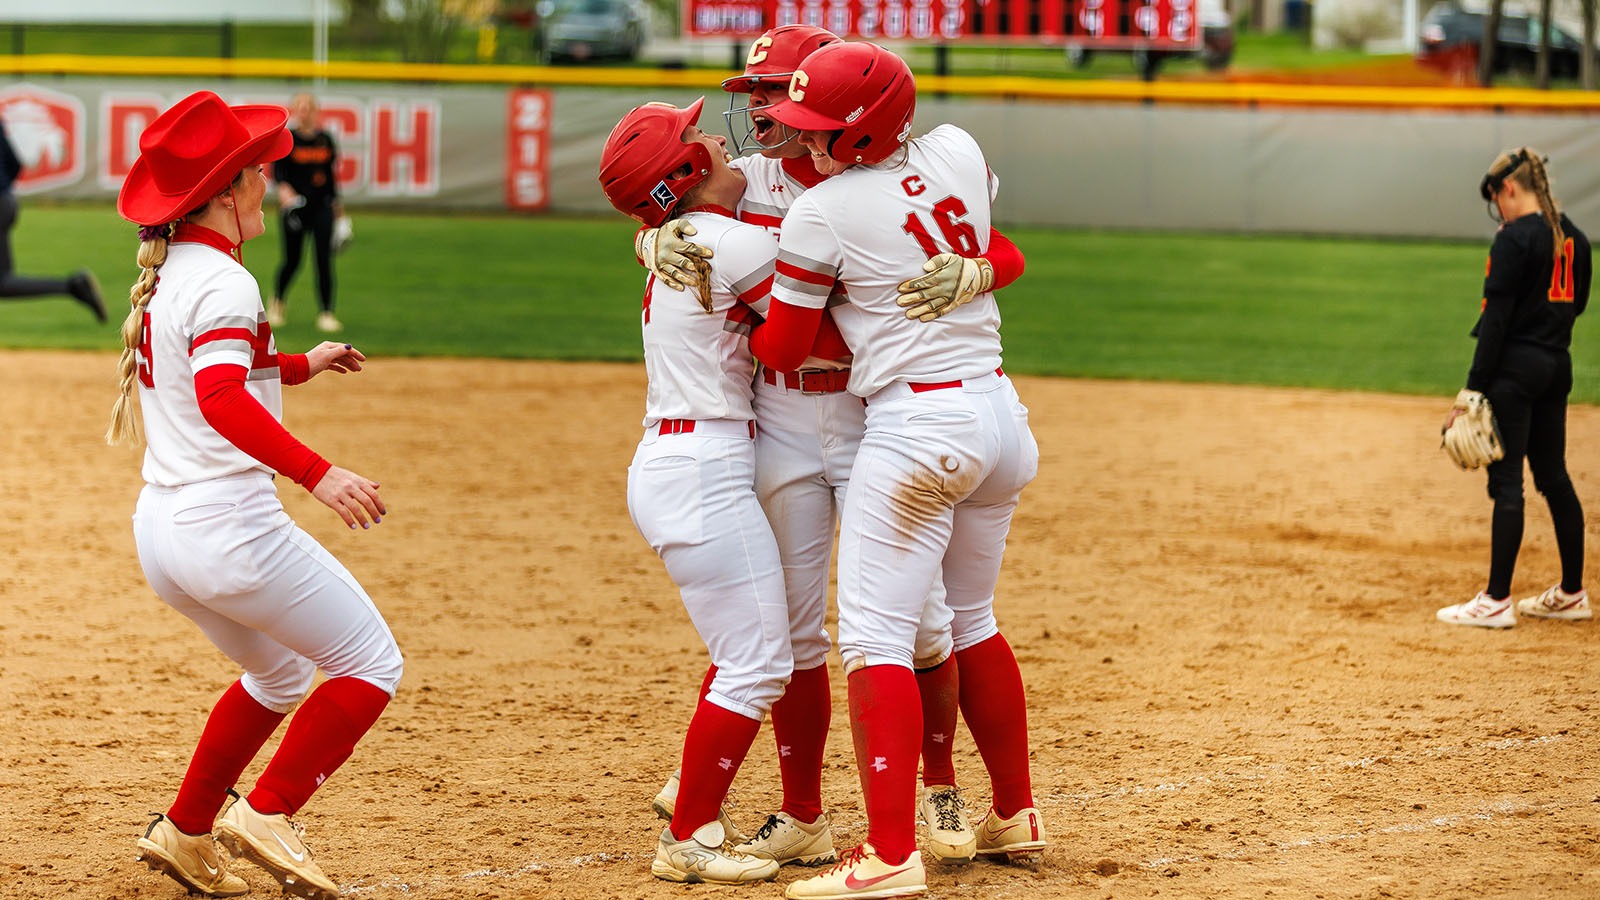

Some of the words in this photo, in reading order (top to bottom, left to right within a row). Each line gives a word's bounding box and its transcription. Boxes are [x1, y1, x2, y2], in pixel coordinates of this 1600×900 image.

[747, 36, 773, 65] C
[788, 70, 810, 102] C
[900, 175, 927, 197] C
[901, 194, 981, 260] 16
[1548, 237, 1575, 303] 11
